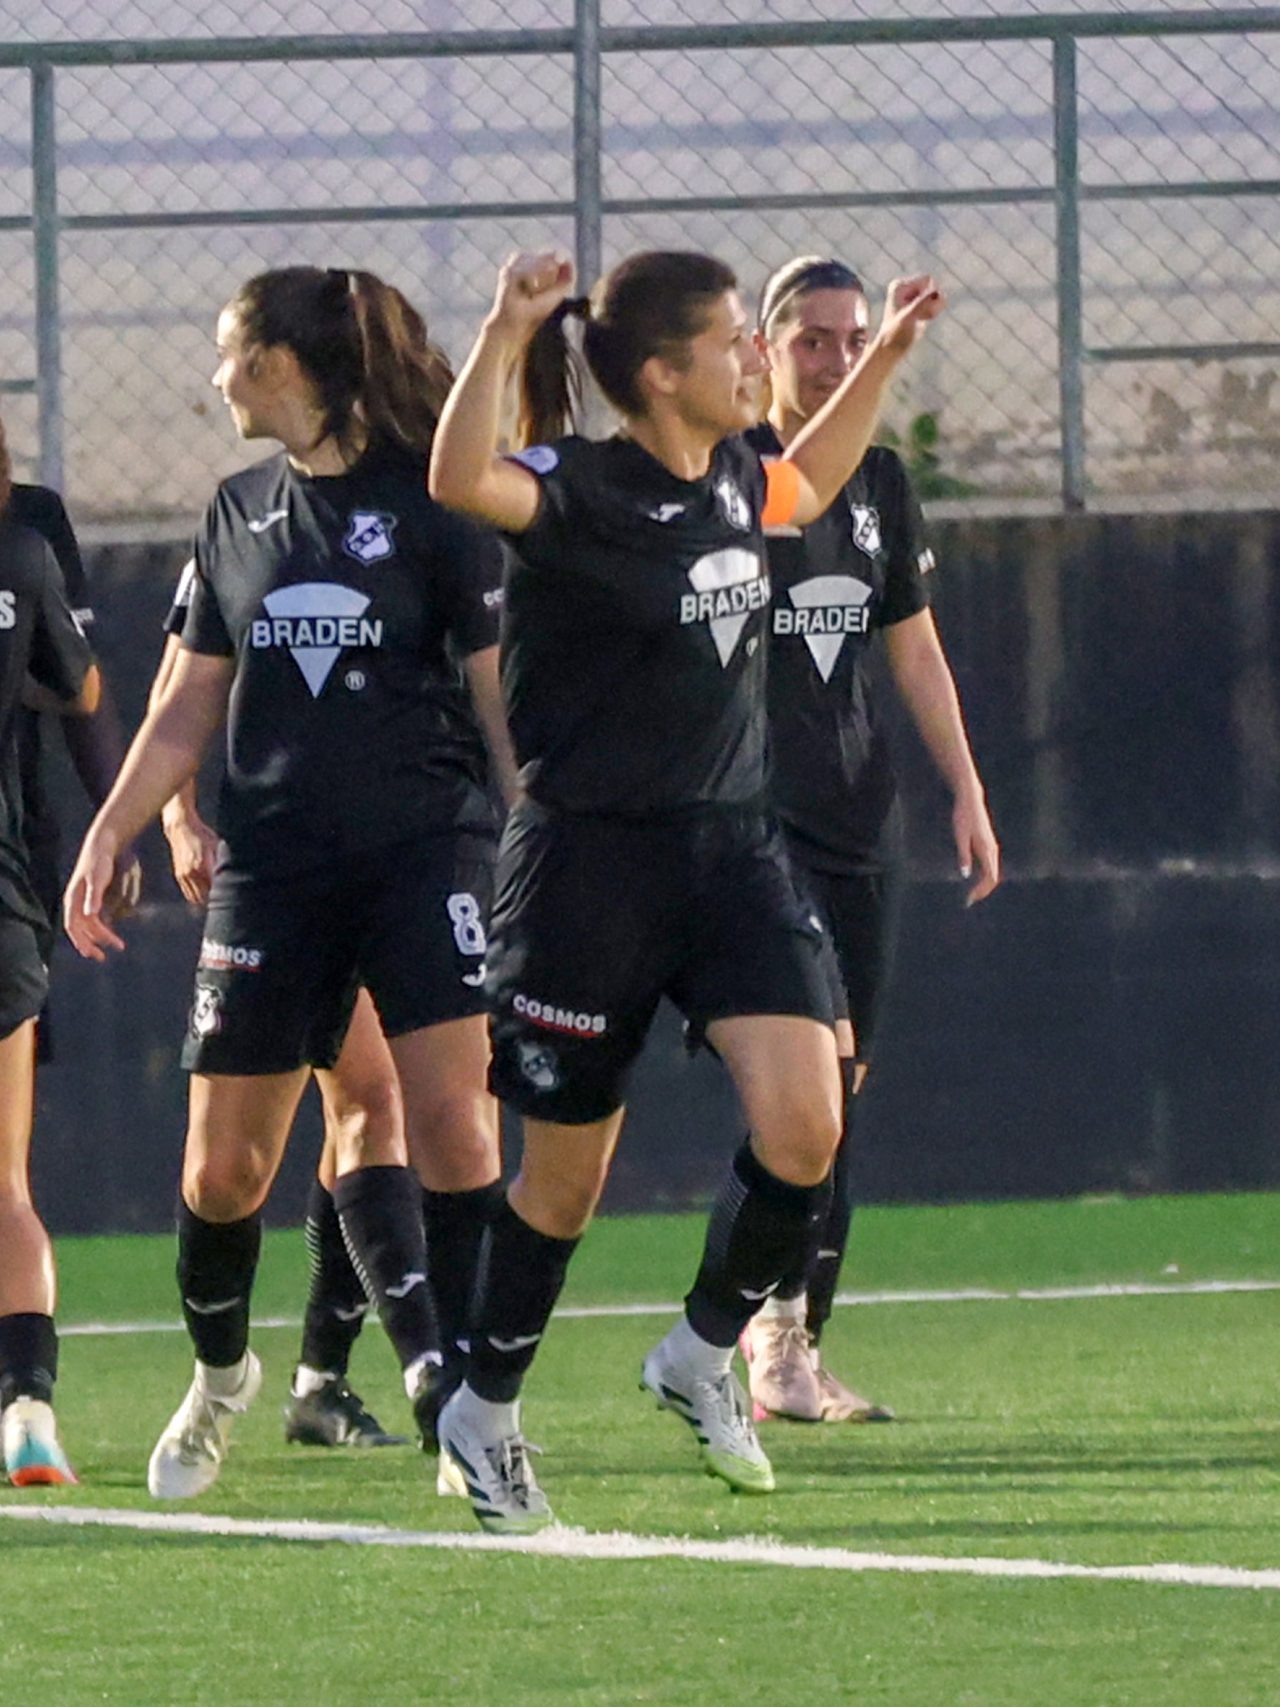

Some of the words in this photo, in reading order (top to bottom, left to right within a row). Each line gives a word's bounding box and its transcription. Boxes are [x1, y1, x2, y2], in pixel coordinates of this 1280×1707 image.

[680, 576, 771, 625] BRADEN
[251, 619, 382, 648] BRADEN
[447, 892, 486, 955] 8
[202, 937, 261, 967] MOS
[513, 994, 606, 1032] COSMOS
